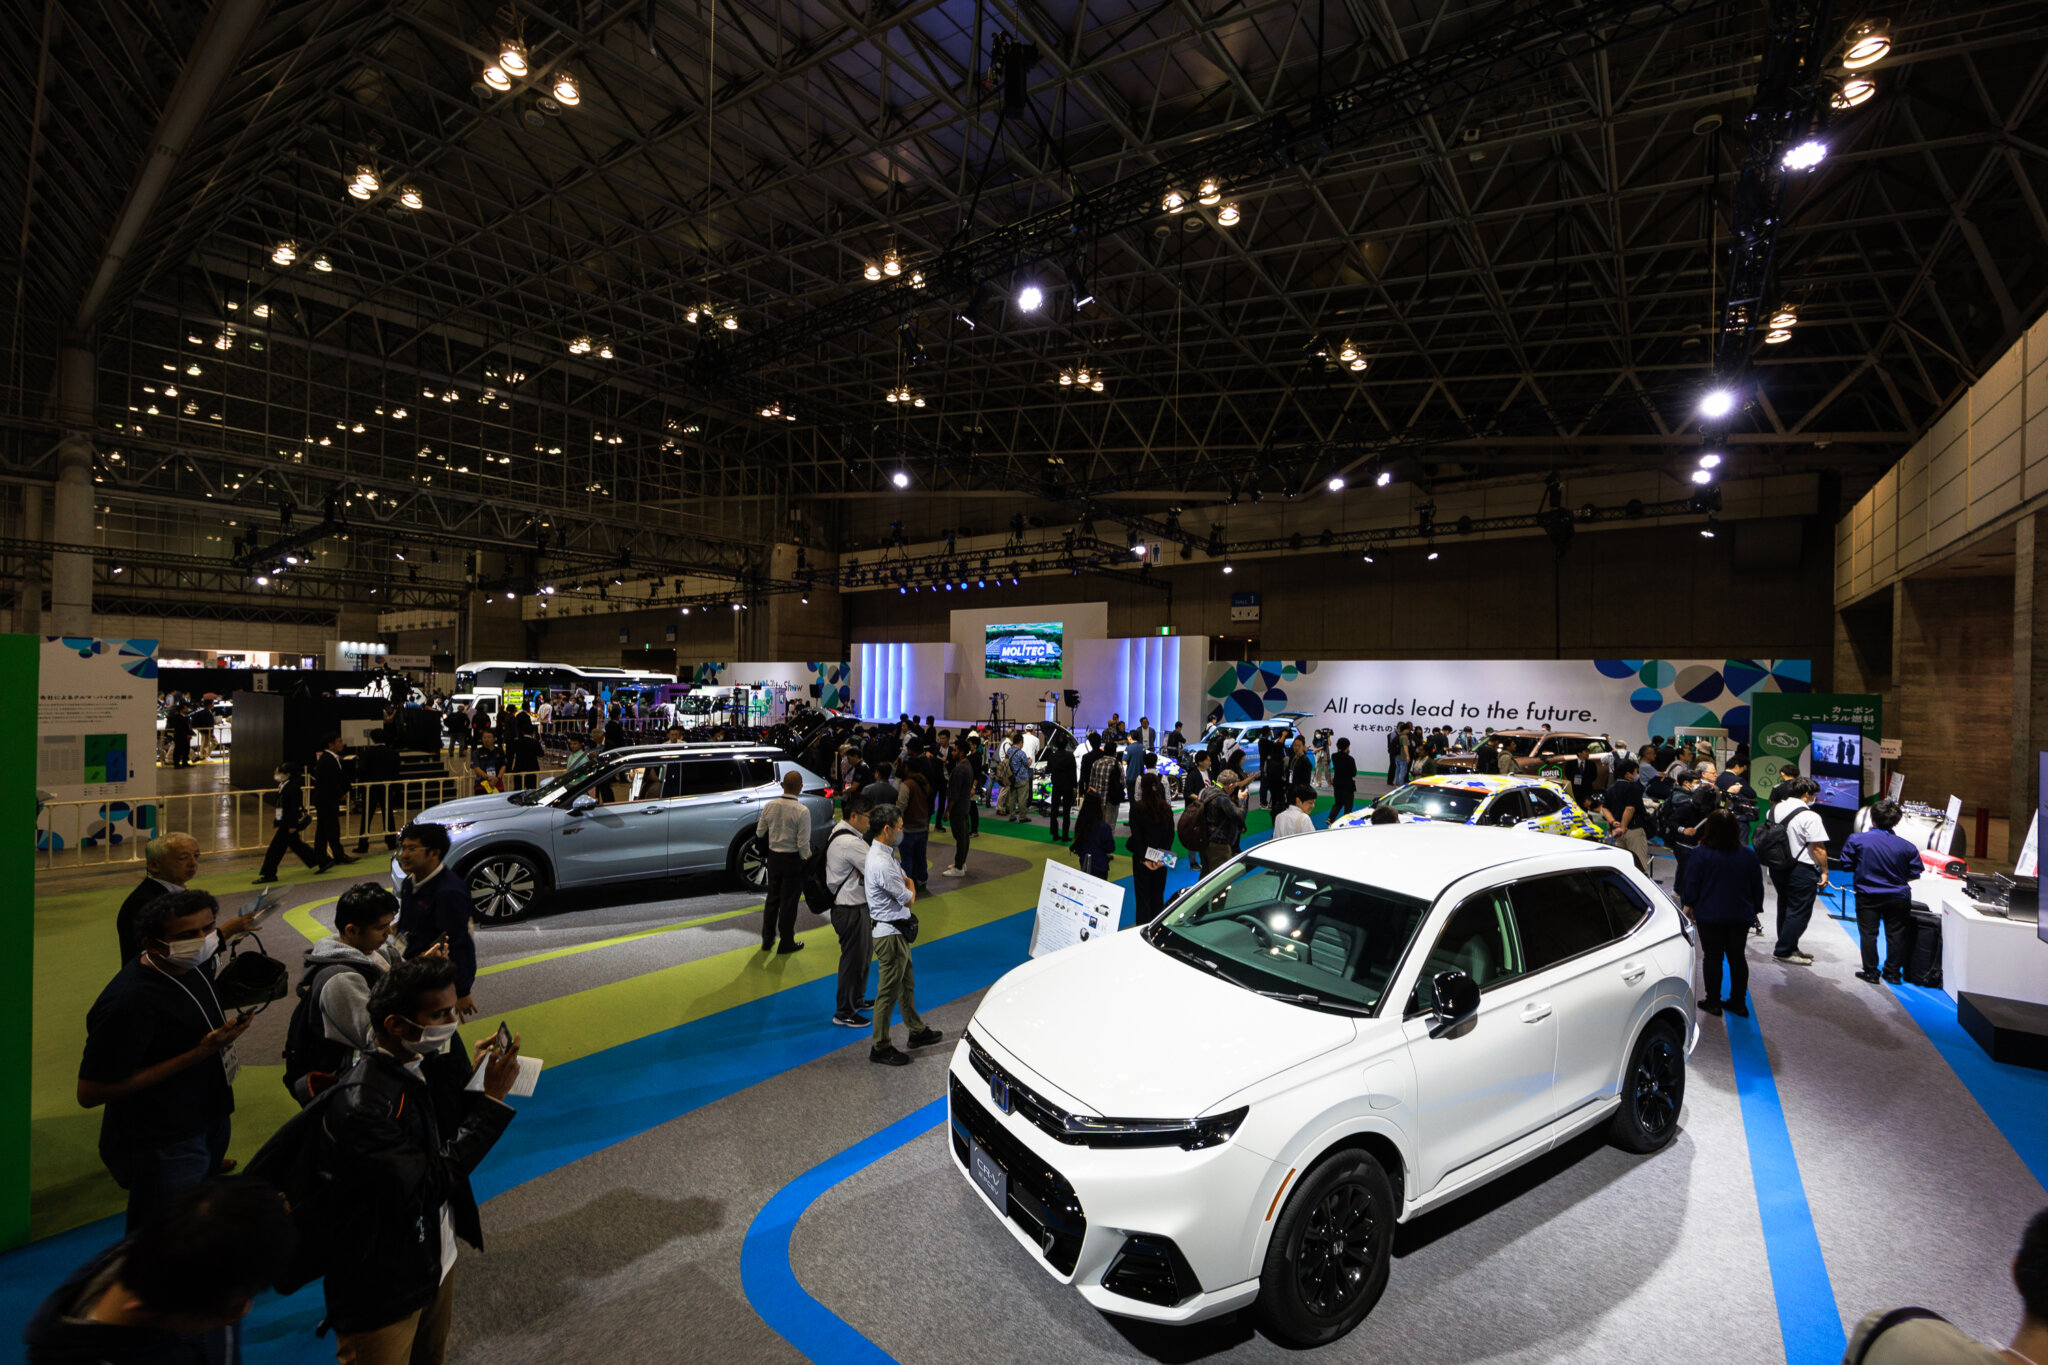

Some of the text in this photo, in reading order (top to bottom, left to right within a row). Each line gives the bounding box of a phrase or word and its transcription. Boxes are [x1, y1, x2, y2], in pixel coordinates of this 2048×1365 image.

[784, 681, 803, 692] Show
[1323, 697, 1598, 723] All roads lead to the future.
[1792, 714, 1874, 723] ニュートラル燃料
[977, 1158, 1000, 1186] CR-V
